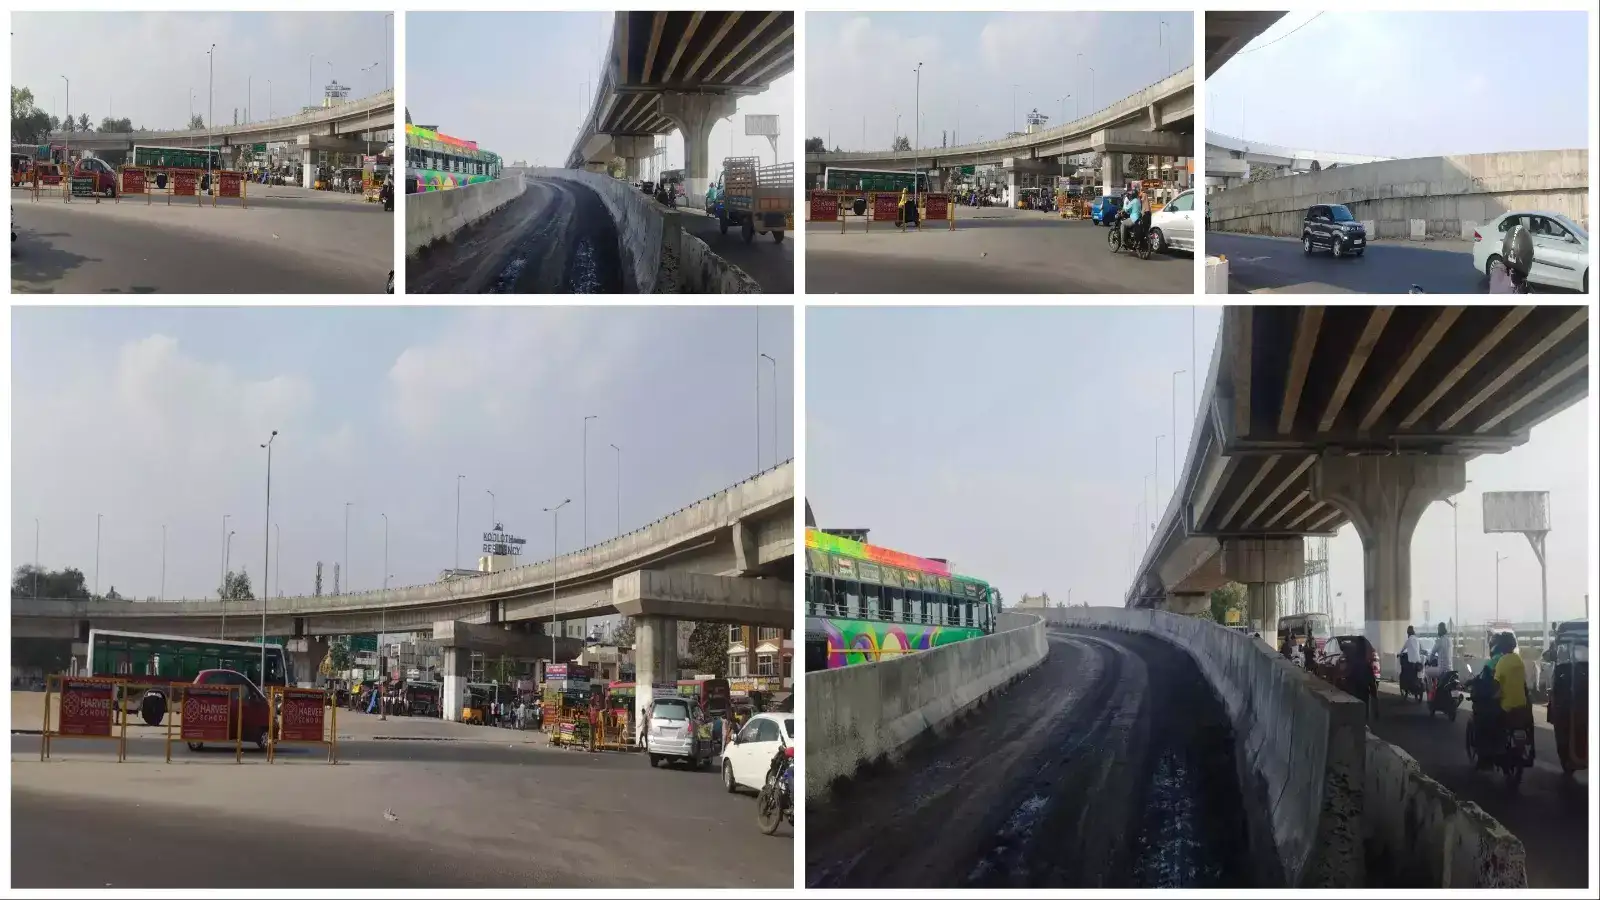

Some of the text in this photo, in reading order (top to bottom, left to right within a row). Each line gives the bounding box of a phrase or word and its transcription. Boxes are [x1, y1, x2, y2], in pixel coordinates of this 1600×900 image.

[80, 697, 111, 709] HARVEE
[200, 703, 228, 714] HARVEE
[298, 707, 323, 717] HARVEE
[199, 714, 227, 722] SCHOOL
